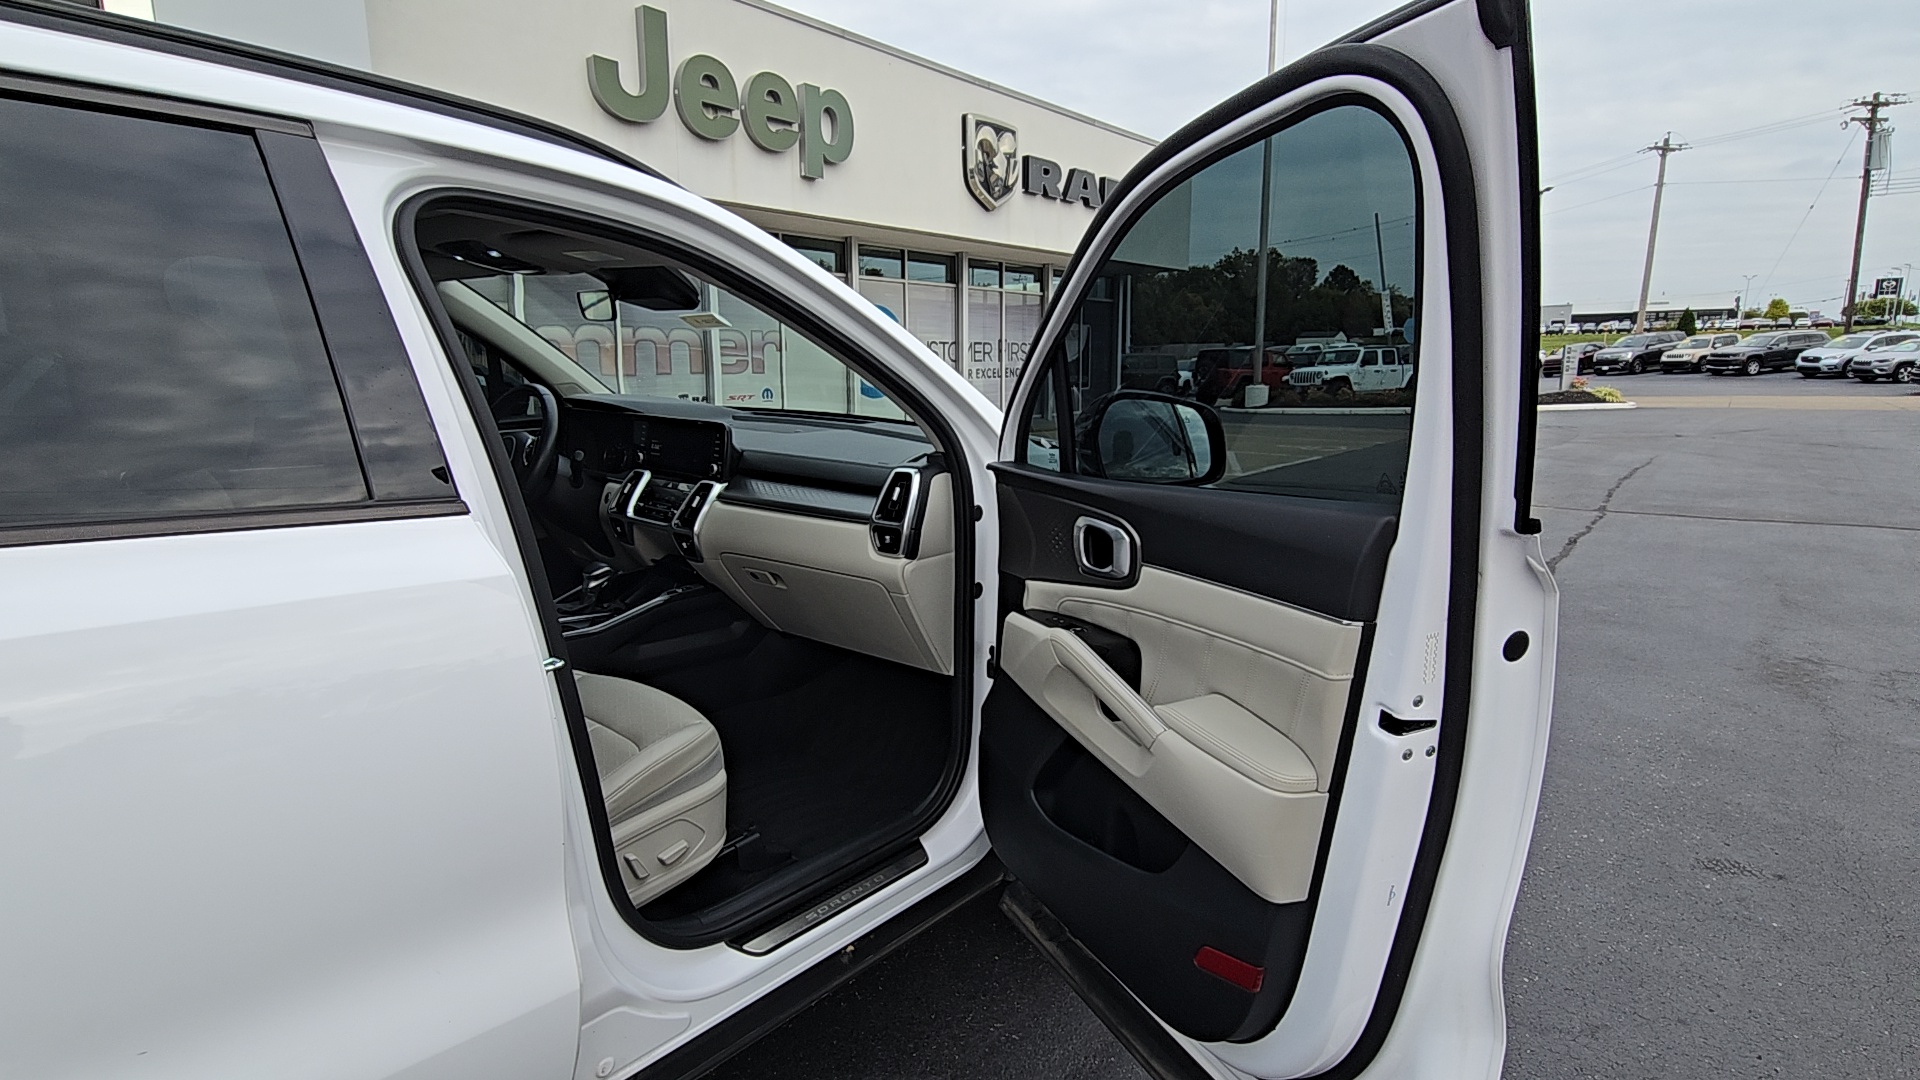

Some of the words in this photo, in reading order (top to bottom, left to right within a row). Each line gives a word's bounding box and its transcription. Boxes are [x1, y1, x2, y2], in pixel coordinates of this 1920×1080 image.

[586, 4, 854, 180] Jeep
[534, 323, 783, 376] mmer
[805, 874, 885, 921] SORENTO
